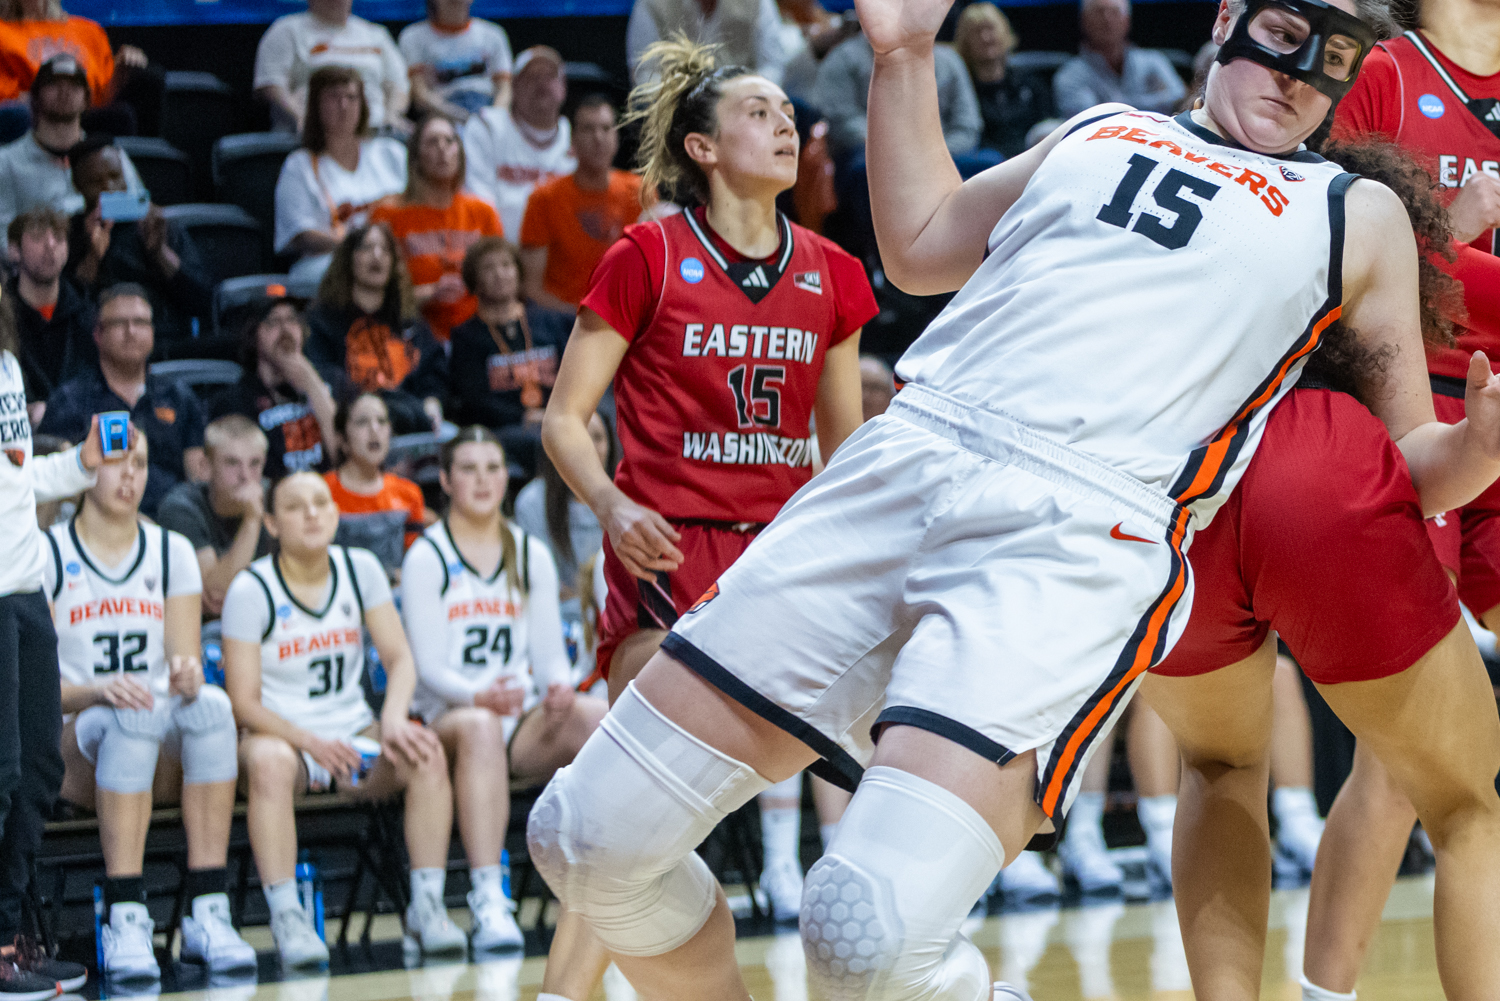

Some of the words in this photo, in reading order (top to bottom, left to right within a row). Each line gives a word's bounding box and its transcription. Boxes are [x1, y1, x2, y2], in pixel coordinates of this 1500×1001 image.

[1085, 125, 1290, 217] BEAVERS
[1096, 153, 1222, 251] 15
[682, 323, 818, 364] EASTERN
[728, 364, 786, 428] 15
[69, 597, 163, 625] BEAVERS
[93, 632, 149, 675] 32
[463, 625, 512, 665] 24
[307, 654, 345, 698] 31
